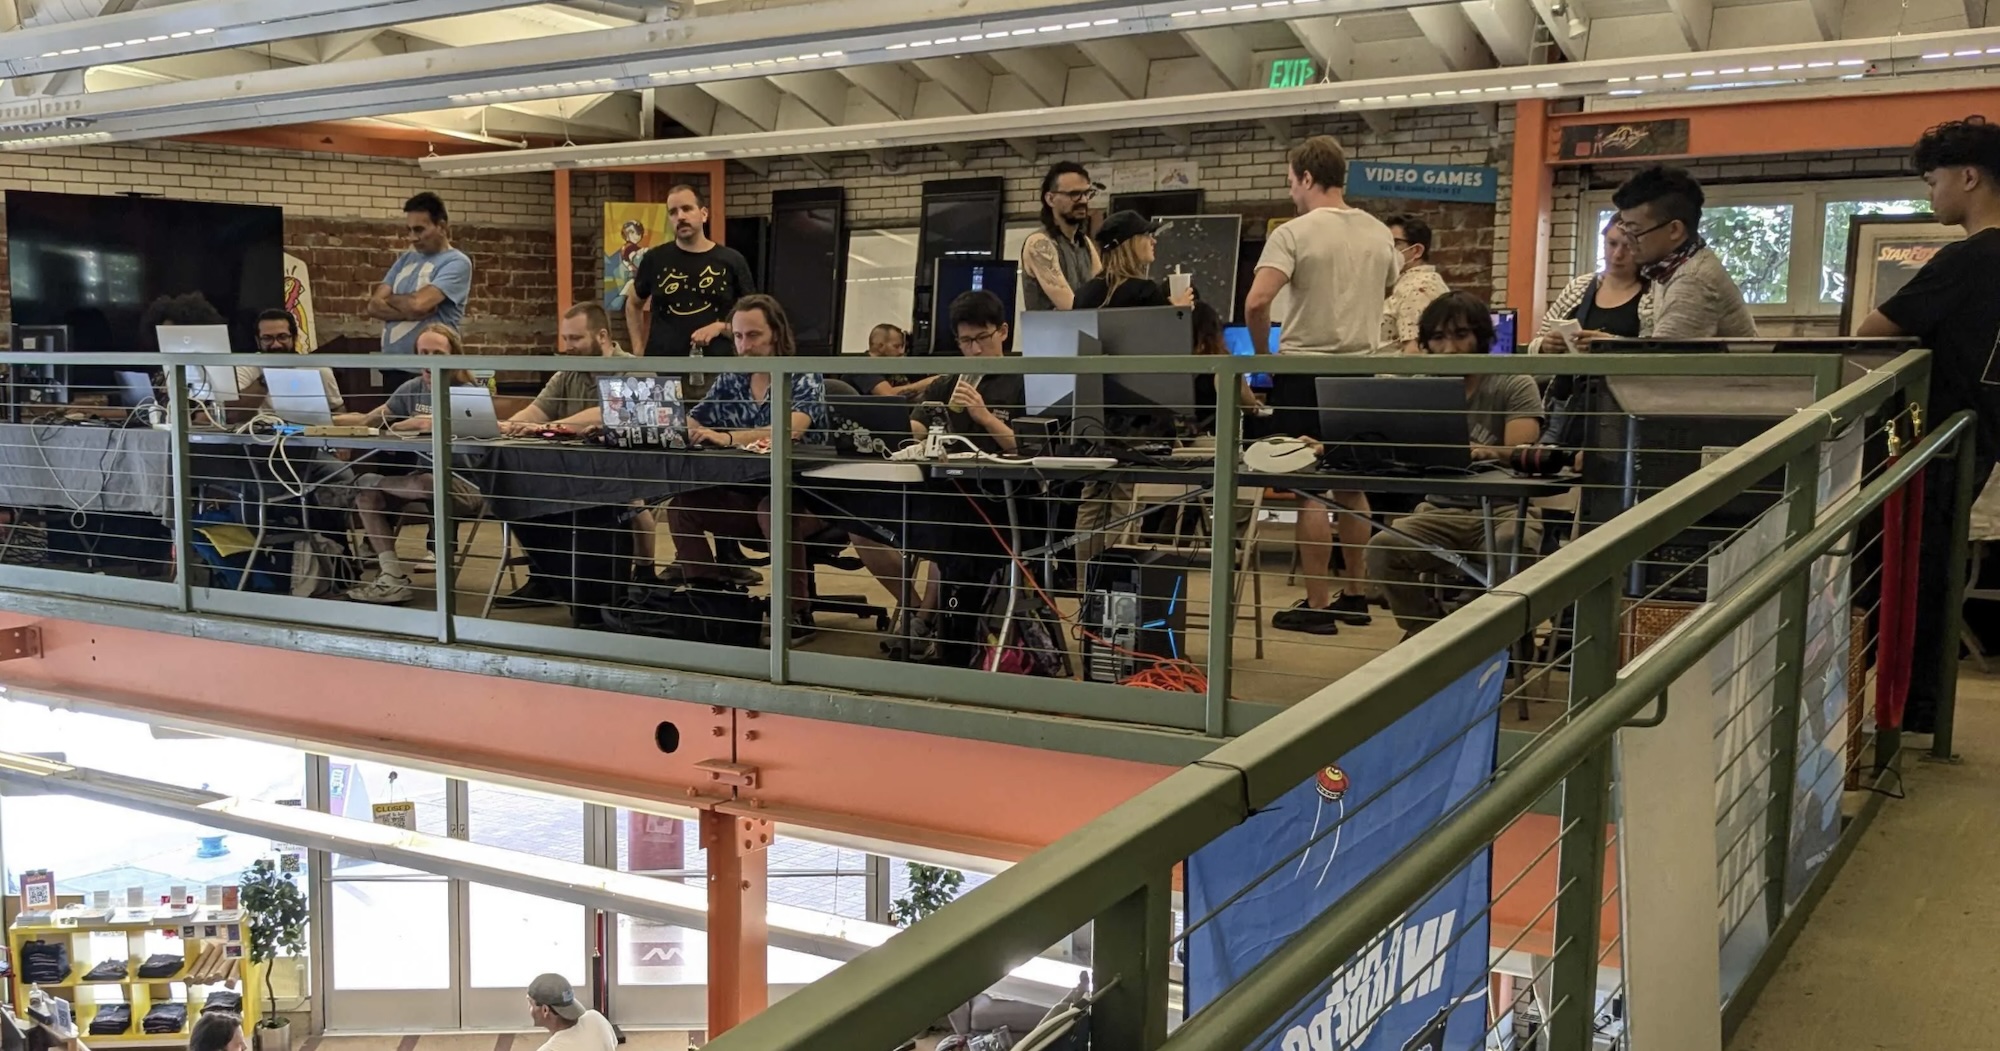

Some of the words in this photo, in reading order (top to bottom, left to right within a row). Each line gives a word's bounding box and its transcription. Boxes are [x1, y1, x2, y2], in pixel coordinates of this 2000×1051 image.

[1269, 58, 1310, 88] EXIT
[1364, 167, 1418, 183] VIDEO
[1422, 170, 1483, 187] GAMES
[375, 804, 411, 813] CLOSED
